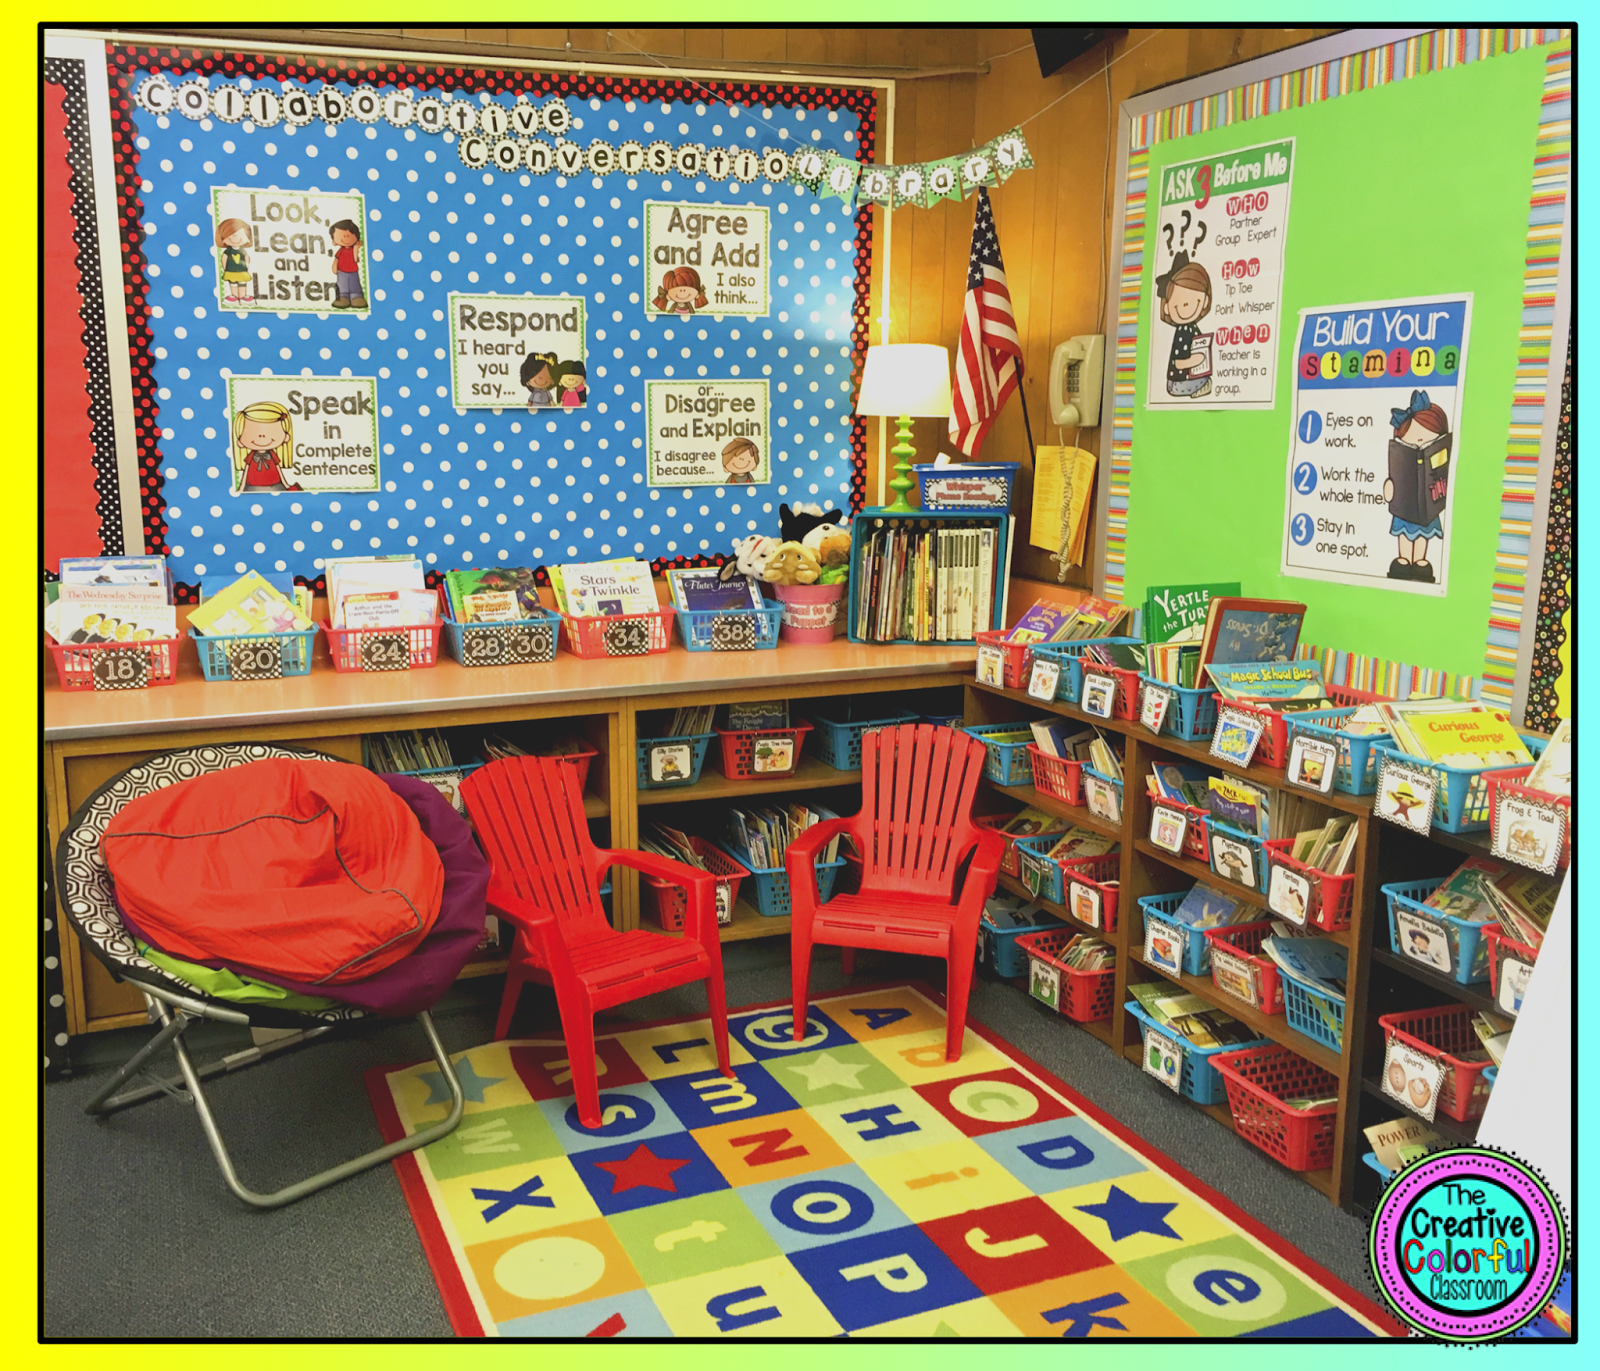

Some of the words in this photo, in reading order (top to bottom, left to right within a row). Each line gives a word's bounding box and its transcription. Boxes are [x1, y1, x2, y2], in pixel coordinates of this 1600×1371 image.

[147, 81, 565, 135] Collaborative
[466, 138, 783, 177] Conversatio
[803, 141, 1023, 194] Library
[1164, 165, 1197, 202] ASK
[1194, 165, 1211, 209] 3
[1214, 159, 1261, 188] Before
[1263, 151, 1287, 178] Me
[250, 194, 330, 226] Look,
[1226, 192, 1268, 215] WHO
[667, 207, 748, 239] Agree
[1230, 215, 1262, 229] Partner
[253, 225, 333, 257] Lean,
[1215, 234, 1240, 247] Group
[1247, 227, 1277, 243] Expert
[275, 254, 309, 272] and
[653, 241, 701, 266] and
[711, 242, 760, 267] Add
[252, 274, 339, 301] Listen
[716, 272, 725, 287] I
[728, 272, 756, 287] also
[1238, 282, 1252, 294] Toe
[714, 290, 758, 304] think...
[1215, 304, 1234, 315] Point
[1238, 302, 1275, 314] Whisper
[459, 304, 578, 337] Respond
[1313, 313, 1373, 347] Build
[1381, 309, 1450, 342] Your
[1216, 326, 1269, 345] When
[458, 339, 467, 356] I
[473, 339, 526, 356] heard
[1219, 350, 1251, 361] Teacher
[478, 363, 509, 378] you
[1217, 367, 1248, 379] working
[1261, 367, 1267, 376] a
[472, 382, 516, 400] say...
[698, 386, 724, 396] or...
[1215, 385, 1240, 397] group.
[287, 390, 375, 420] Speak
[665, 394, 755, 417] Disagree
[660, 423, 688, 438] and
[692, 417, 761, 442] Explain
[1306, 413, 1312, 441] 1
[1326, 412, 1353, 430] Eyes
[1357, 416, 1373, 427] on
[323, 422, 341, 440] in
[1325, 434, 1356, 448] work.
[295, 443, 373, 462] Complete
[654, 451, 661, 462] I
[664, 450, 716, 463] disagree
[292, 461, 376, 477] Sentences
[656, 465, 714, 476] because...
[1298, 464, 1310, 491] 2
[1321, 467, 1350, 481] Work
[1354, 467, 1374, 482] the
[946, 482, 986, 493] Whisper
[1320, 489, 1353, 503] whole
[1357, 492, 1386, 505] time.
[1296, 516, 1307, 541] 3
[1317, 518, 1342, 535] Stay
[1315, 541, 1337, 554] one
[1340, 543, 1369, 559] spot.
[580, 575, 616, 585] Stars
[685, 579, 713, 590] Flute's
[713, 580, 746, 592] Journey
[82, 590, 127, 601] Wednesday
[128, 591, 162, 601] Surprise
[589, 585, 641, 596] Twinkle
[812, 603, 824, 615] to
[1153, 589, 1209, 618] YERTLE
[790, 615, 826, 626] Puppet
[1163, 621, 1178, 633] the
[1226, 619, 1252, 637] Seuss
[614, 628, 641, 647] 34
[719, 624, 751, 641] 38+
[371, 643, 401, 662] 24
[472, 638, 500, 657] 28
[517, 635, 546, 654] 30
[239, 650, 273, 669] 20
[106, 659, 134, 680] 18
[1230, 672, 1261, 684] Magic
[1260, 667, 1291, 681] School
[1292, 667, 1312, 681] Bus
[1428, 720, 1480, 732] Curious
[1296, 738, 1318, 751] Horrible
[1320, 744, 1334, 757] Harry
[1459, 732, 1505, 744] George
[1386, 766, 1408, 782] Curious
[1410, 775, 1431, 790] George
[1223, 786, 1237, 798] ZACK
[1507, 802, 1524, 817] Frog
[1536, 810, 1554, 824] Toad
[1221, 838, 1242, 853] Mystery
[1150, 923, 1165, 936] Chapter
[1167, 930, 1180, 943] Books
[1399, 913, 1420, 929] Amelia
[1422, 922, 1444, 939] Bedelia
[848, 1007, 912, 1031] A
[652, 1037, 710, 1064] L
[1402, 1053, 1424, 1072] Sports
[840, 1104, 921, 1140] H
[1377, 1126, 1421, 1147] POWER
[728, 1127, 810, 1167] N
[1017, 1134, 1094, 1169] D
[471, 1175, 556, 1223] X
[964, 1227, 1049, 1258] J
[839, 1254, 927, 1293] P
[1193, 1269, 1261, 1306] e
[1041, 1292, 1130, 1336] K
